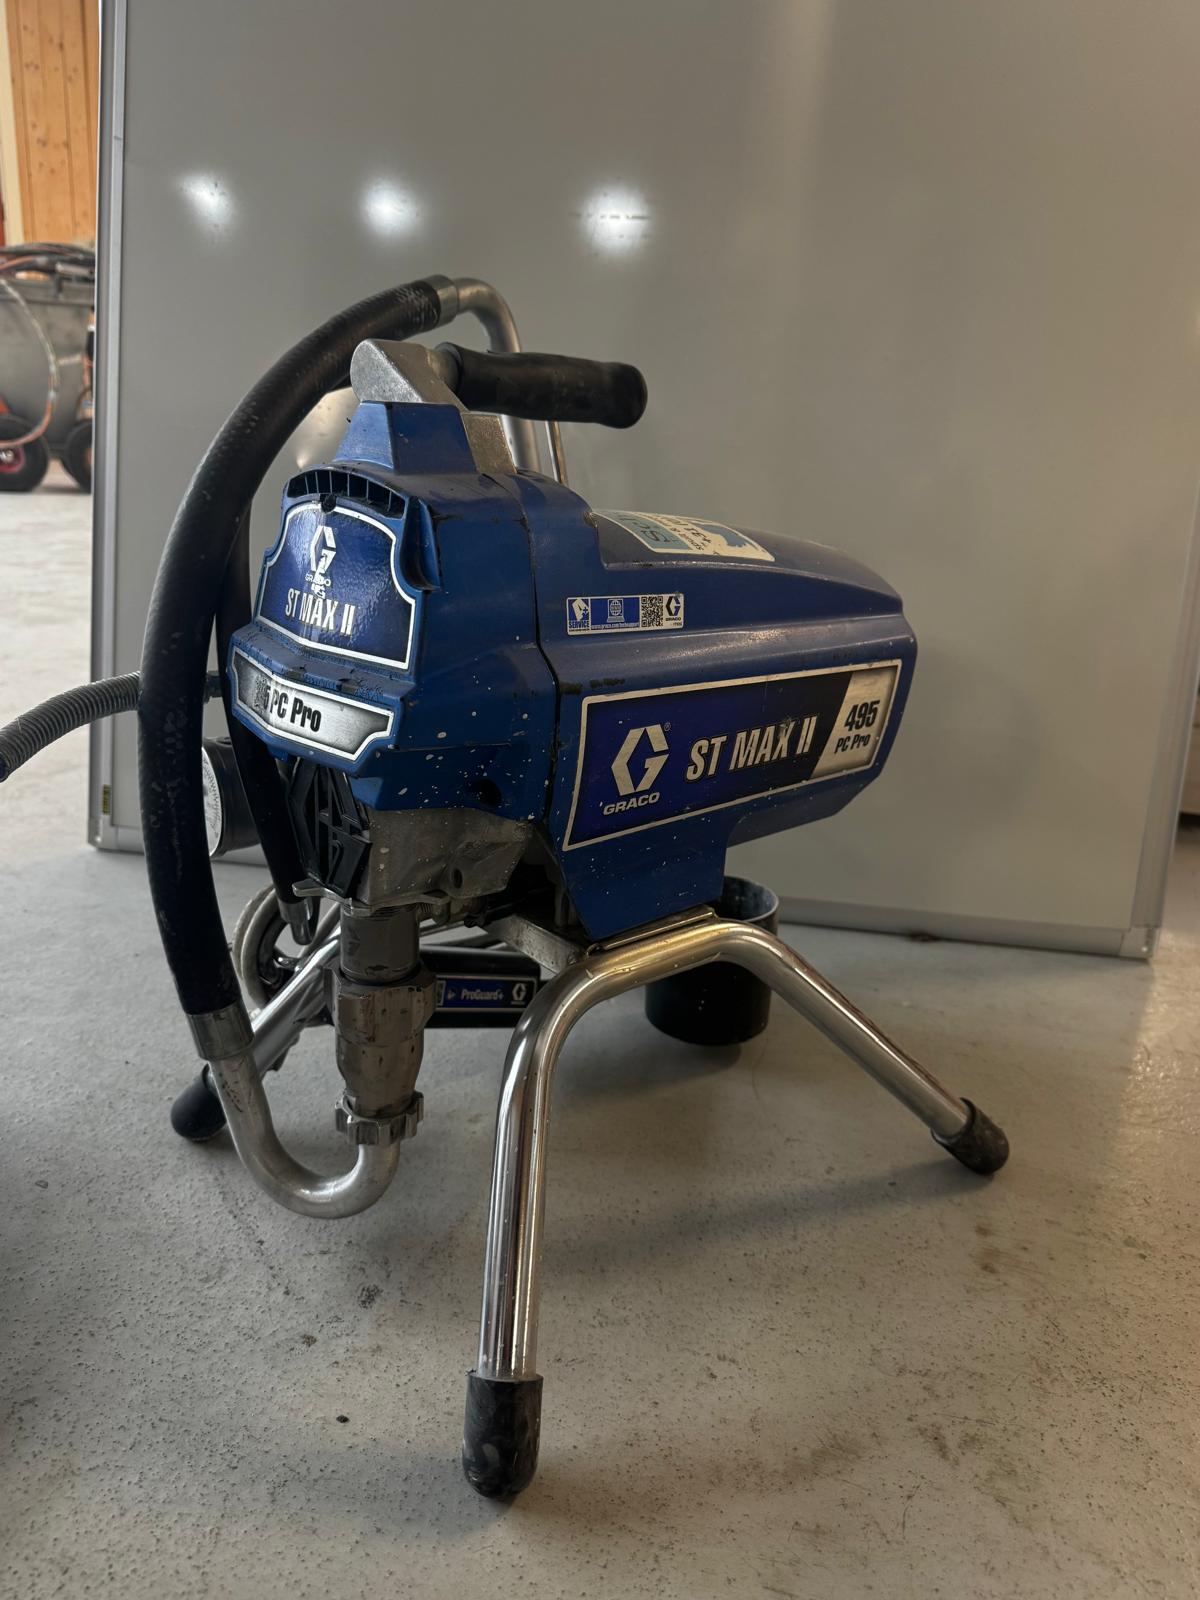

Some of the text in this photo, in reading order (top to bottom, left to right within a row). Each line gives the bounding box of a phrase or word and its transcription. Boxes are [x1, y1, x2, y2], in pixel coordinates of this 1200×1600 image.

[286, 588, 301, 617] ST
[299, 592, 338, 631] MAX
[290, 697, 322, 733] Pro
[845, 700, 881, 733] 495
[686, 734, 728, 784] ST
[729, 719, 796, 772] MAX
[834, 733, 870, 755] PC Pro
[603, 791, 661, 816] GRACO
